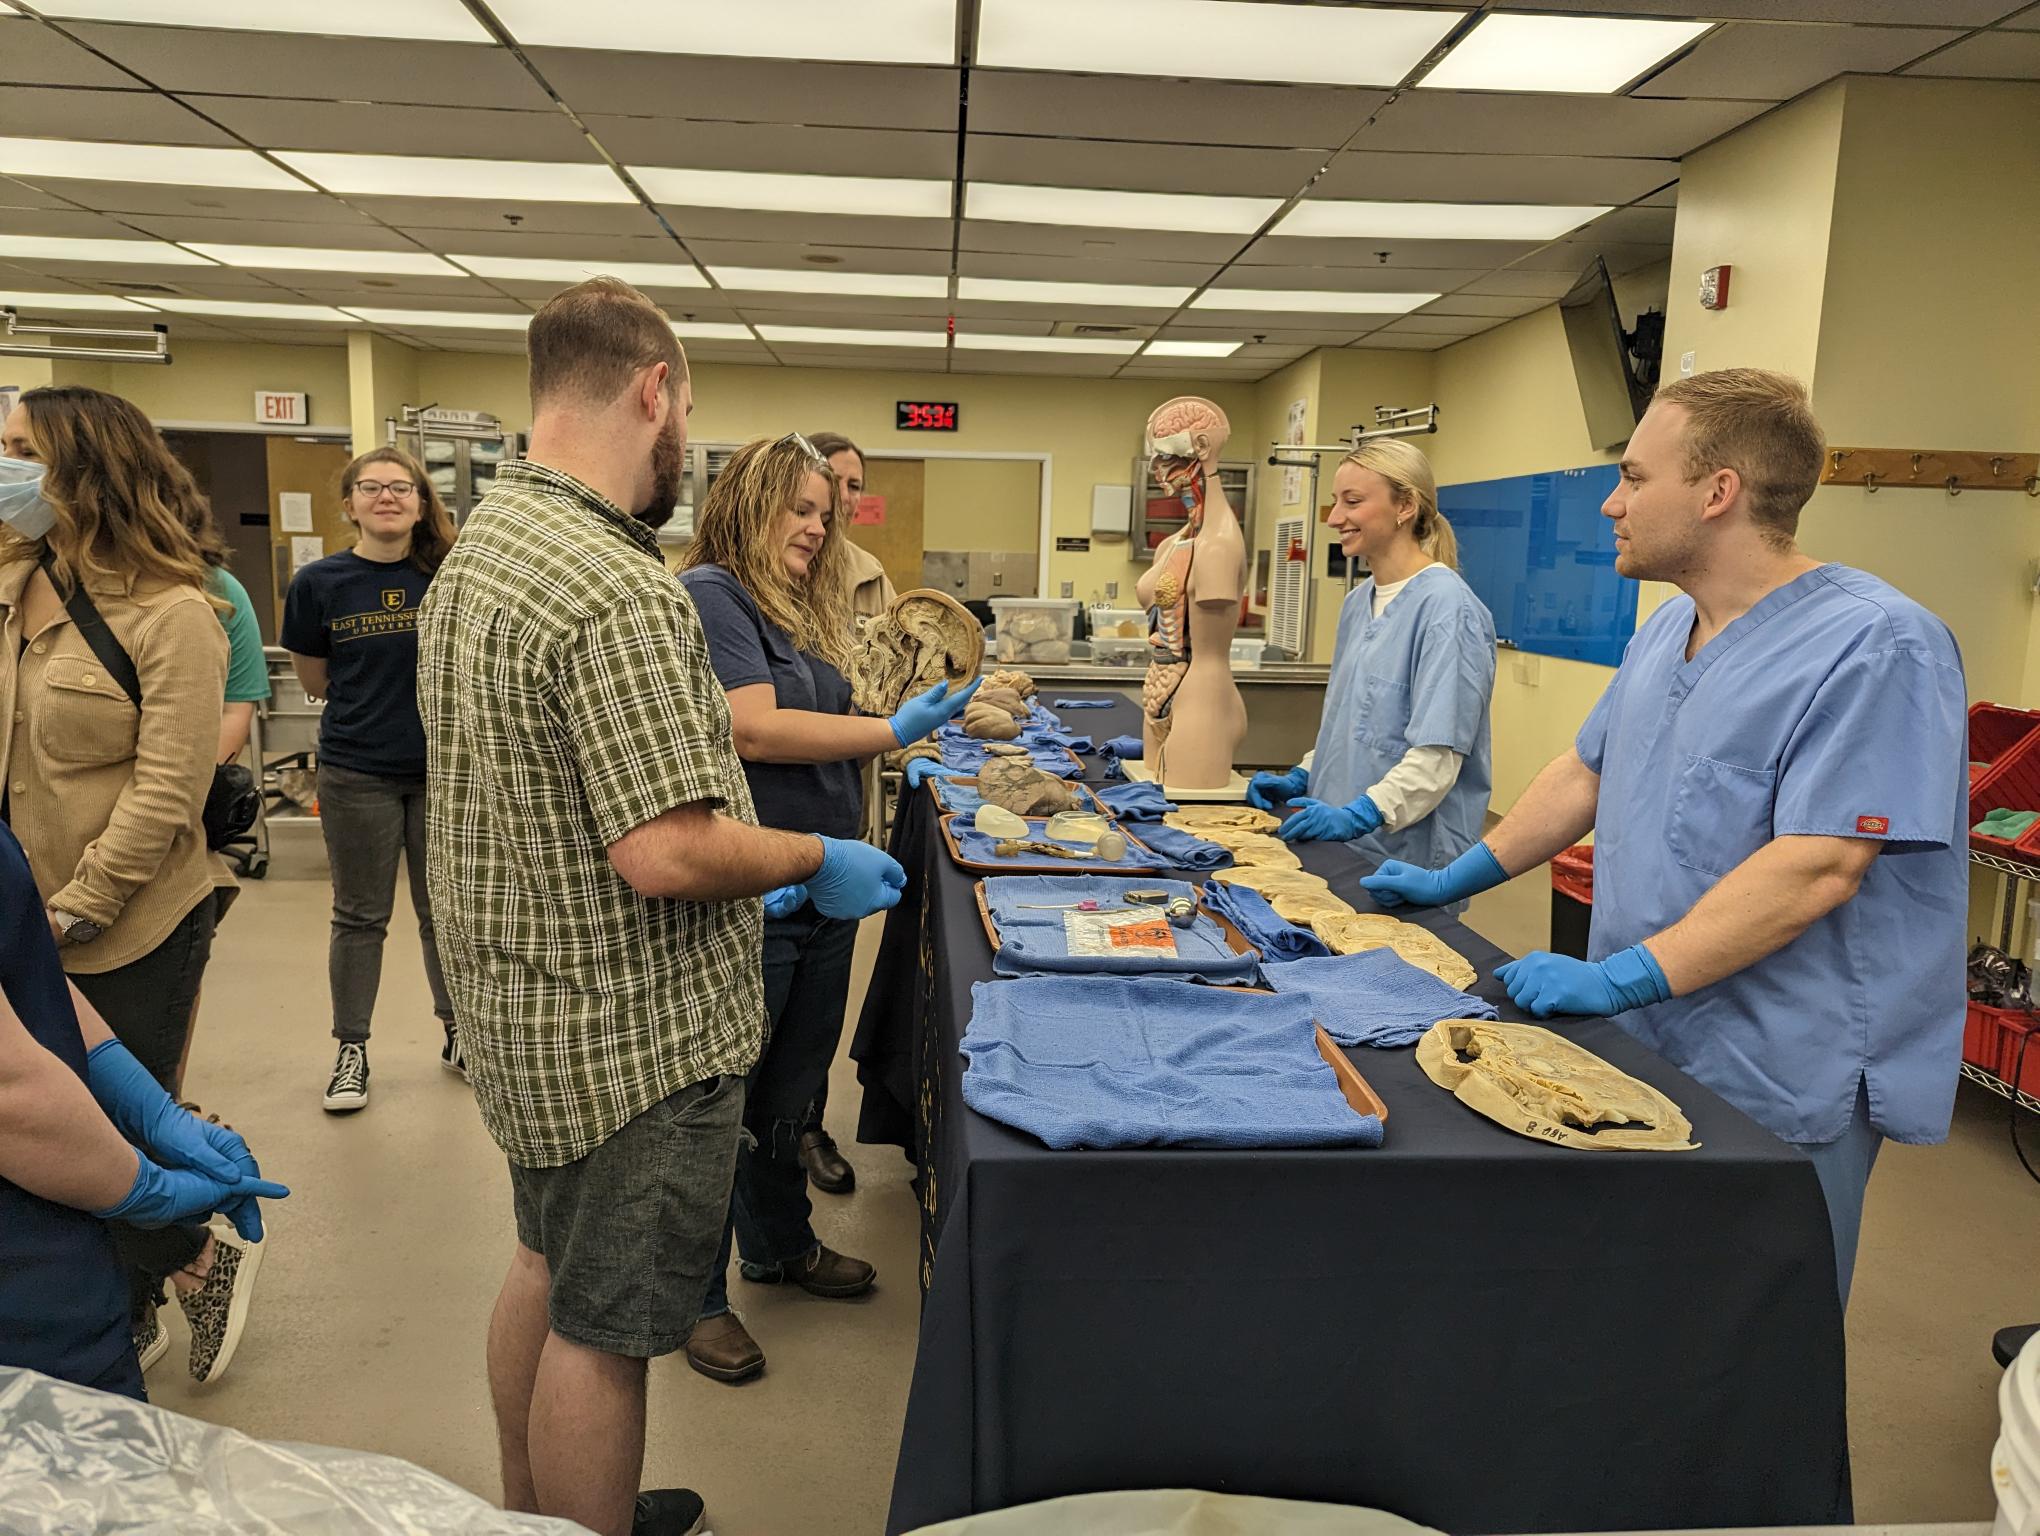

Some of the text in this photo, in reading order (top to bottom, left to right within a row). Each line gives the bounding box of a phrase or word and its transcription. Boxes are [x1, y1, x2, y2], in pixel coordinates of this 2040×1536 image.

[265, 396, 295, 419] EXIT
[387, 593, 401, 606] E
[331, 611, 417, 631] EAST TENNESSE
[353, 621, 413, 635] UNIVERS
